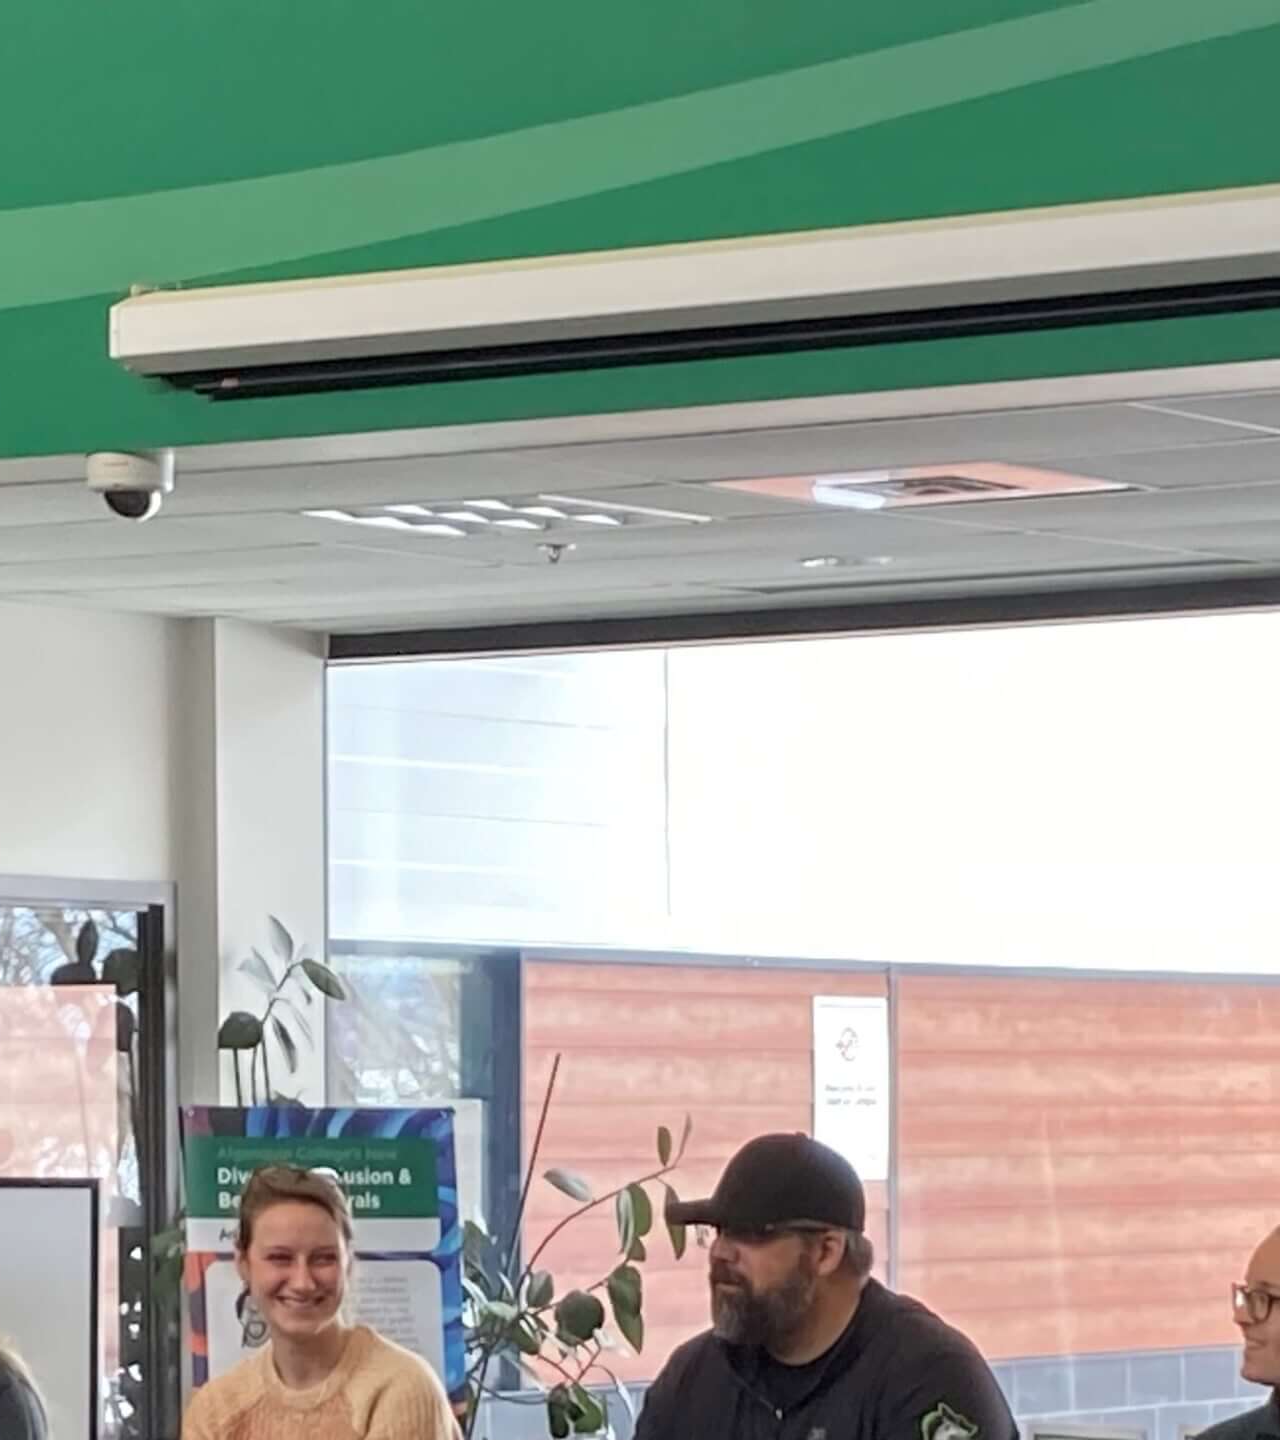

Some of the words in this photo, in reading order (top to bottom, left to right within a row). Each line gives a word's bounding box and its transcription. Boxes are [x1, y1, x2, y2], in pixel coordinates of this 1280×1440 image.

[340, 1167, 394, 1185] usion
[399, 1167, 412, 1184] &
[353, 1192, 381, 1209] rals
